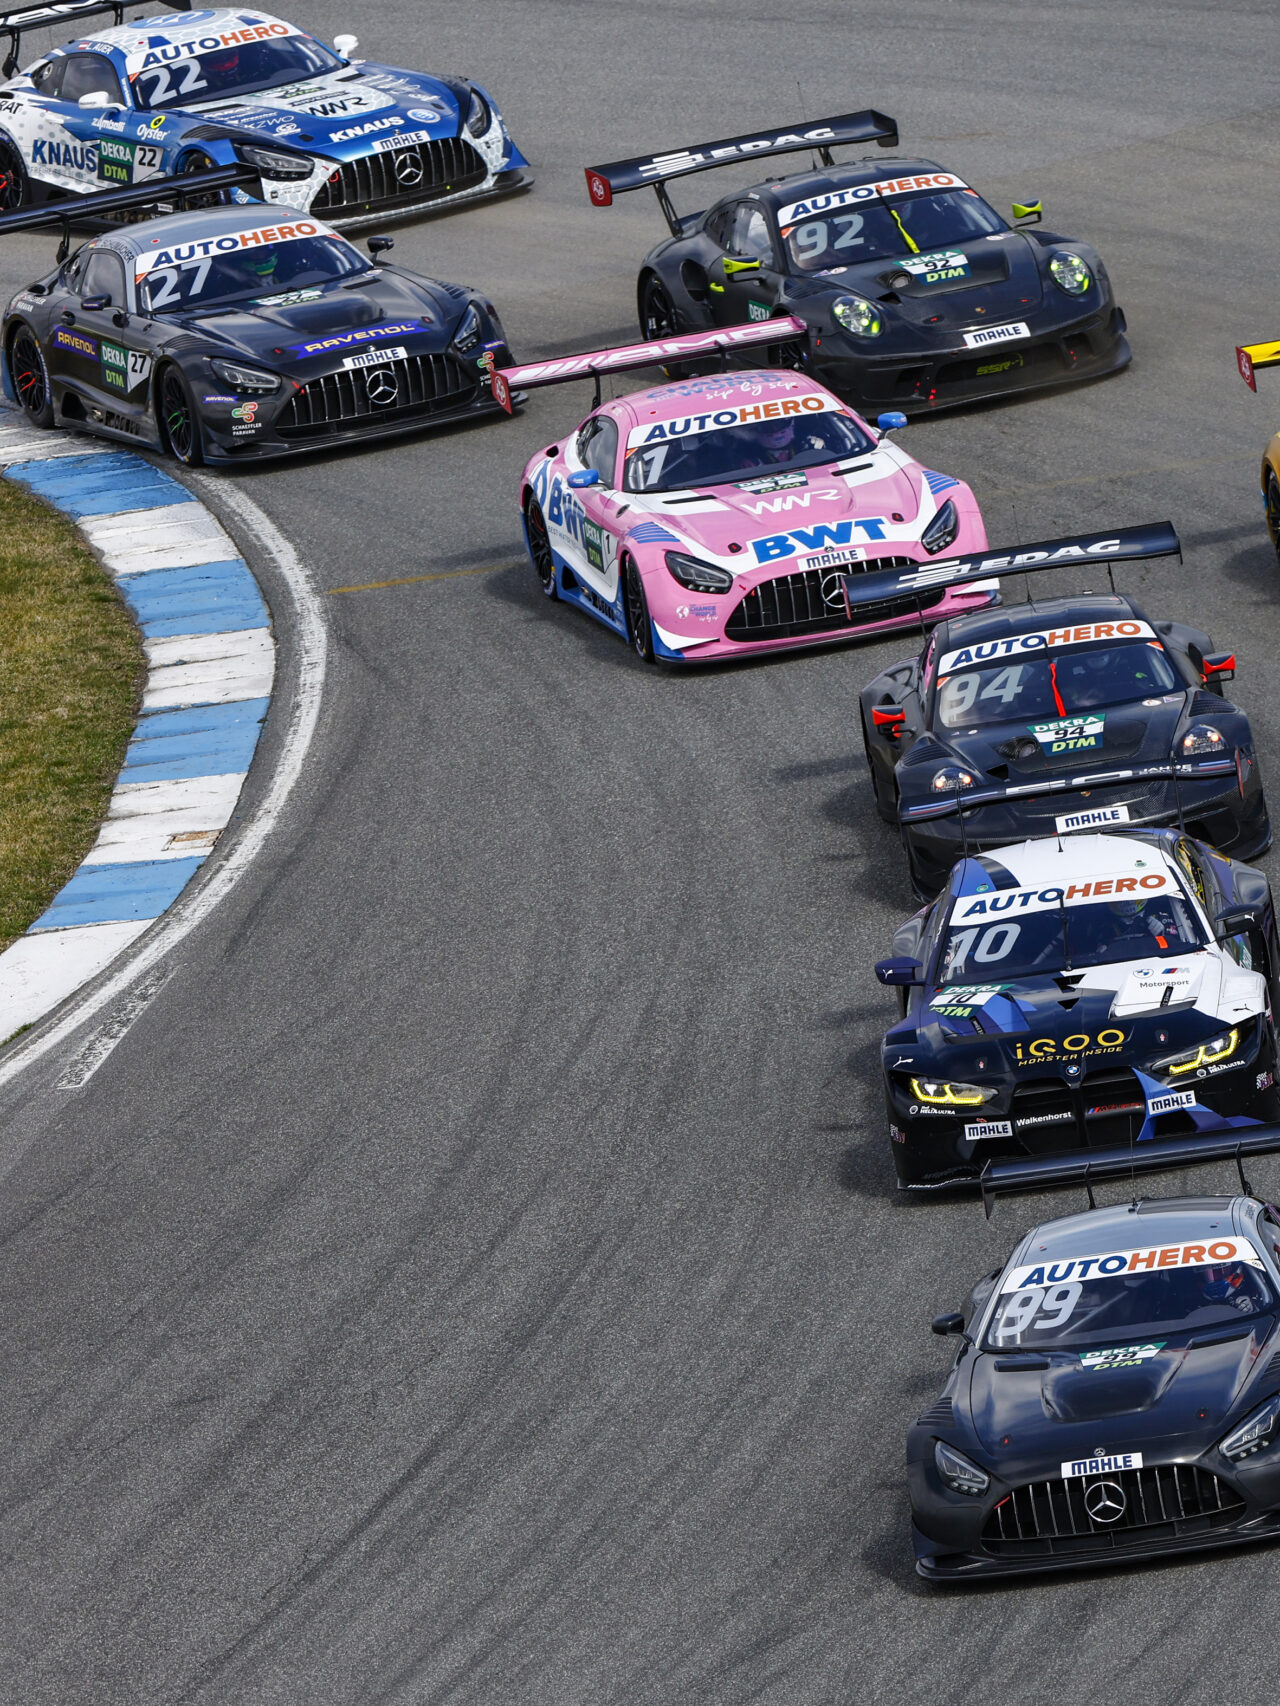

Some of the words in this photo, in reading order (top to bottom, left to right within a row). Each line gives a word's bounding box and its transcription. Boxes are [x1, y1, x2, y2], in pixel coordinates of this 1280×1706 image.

[142, 23, 290, 68] AUTOHERO
[140, 57, 209, 108] 22
[137, 123, 169, 142] Oyster
[329, 116, 406, 143] KNAUS
[380, 132, 424, 150] MAHLE
[711, 127, 836, 159] EDAG
[32, 139, 97, 173] KNAUS
[101, 141, 133, 163] DEKRA
[138, 147, 157, 168] 22
[104, 164, 128, 181] DTM
[790, 174, 954, 220] AUTOHERO
[151, 222, 317, 269] AUTOHERO
[796, 213, 865, 260] 92
[900, 251, 959, 267] DEKRA
[924, 258, 951, 271] 92
[147, 256, 213, 310] 27
[926, 267, 966, 283] DTM
[57, 331, 96, 356] RAVENOL
[304, 323, 416, 352] RAVENOL
[973, 326, 1022, 343] MAHLE
[101, 345, 127, 369] DEKRA
[130, 353, 147, 374] 27
[352, 348, 400, 367] MAHLE
[105, 369, 125, 388] DTM
[644, 396, 825, 443] AUTOHERO
[642, 445, 670, 486] 1
[606, 534, 611, 554] 1
[752, 517, 887, 564] BWT
[806, 549, 859, 569] MAHLE
[979, 539, 1121, 571] EDAG
[950, 622, 1142, 669] AUTOHERO
[950, 665, 1025, 718] 94
[1033, 715, 1101, 732] DEKRA
[1053, 727, 1087, 739] 94
[1052, 736, 1096, 753] DTM
[1064, 809, 1120, 828] MAHLE
[962, 874, 1167, 918] AUTOHERO
[950, 922, 1022, 968] 10
[943, 985, 1002, 994] DEKRA
[1139, 979, 1190, 989] Motorsport
[948, 993, 978, 1004] 10
[929, 1006, 973, 1017] DTM
[1016, 1028, 1125, 1059] iQOO
[1018, 1052, 1078, 1067] MONSTER
[1080, 1045, 1124, 1060] INSIDE
[1151, 1093, 1192, 1111] MAHLE
[1016, 1111, 1072, 1127] Walkenhorst
[968, 1124, 1009, 1137] MAHLE
[1018, 1241, 1238, 1288] AUTOHERO
[994, 1281, 1083, 1337] 99
[1085, 1344, 1157, 1359] DEKRA
[1093, 1359, 1143, 1371] DTM
[1071, 1455, 1133, 1475] MAHLE
